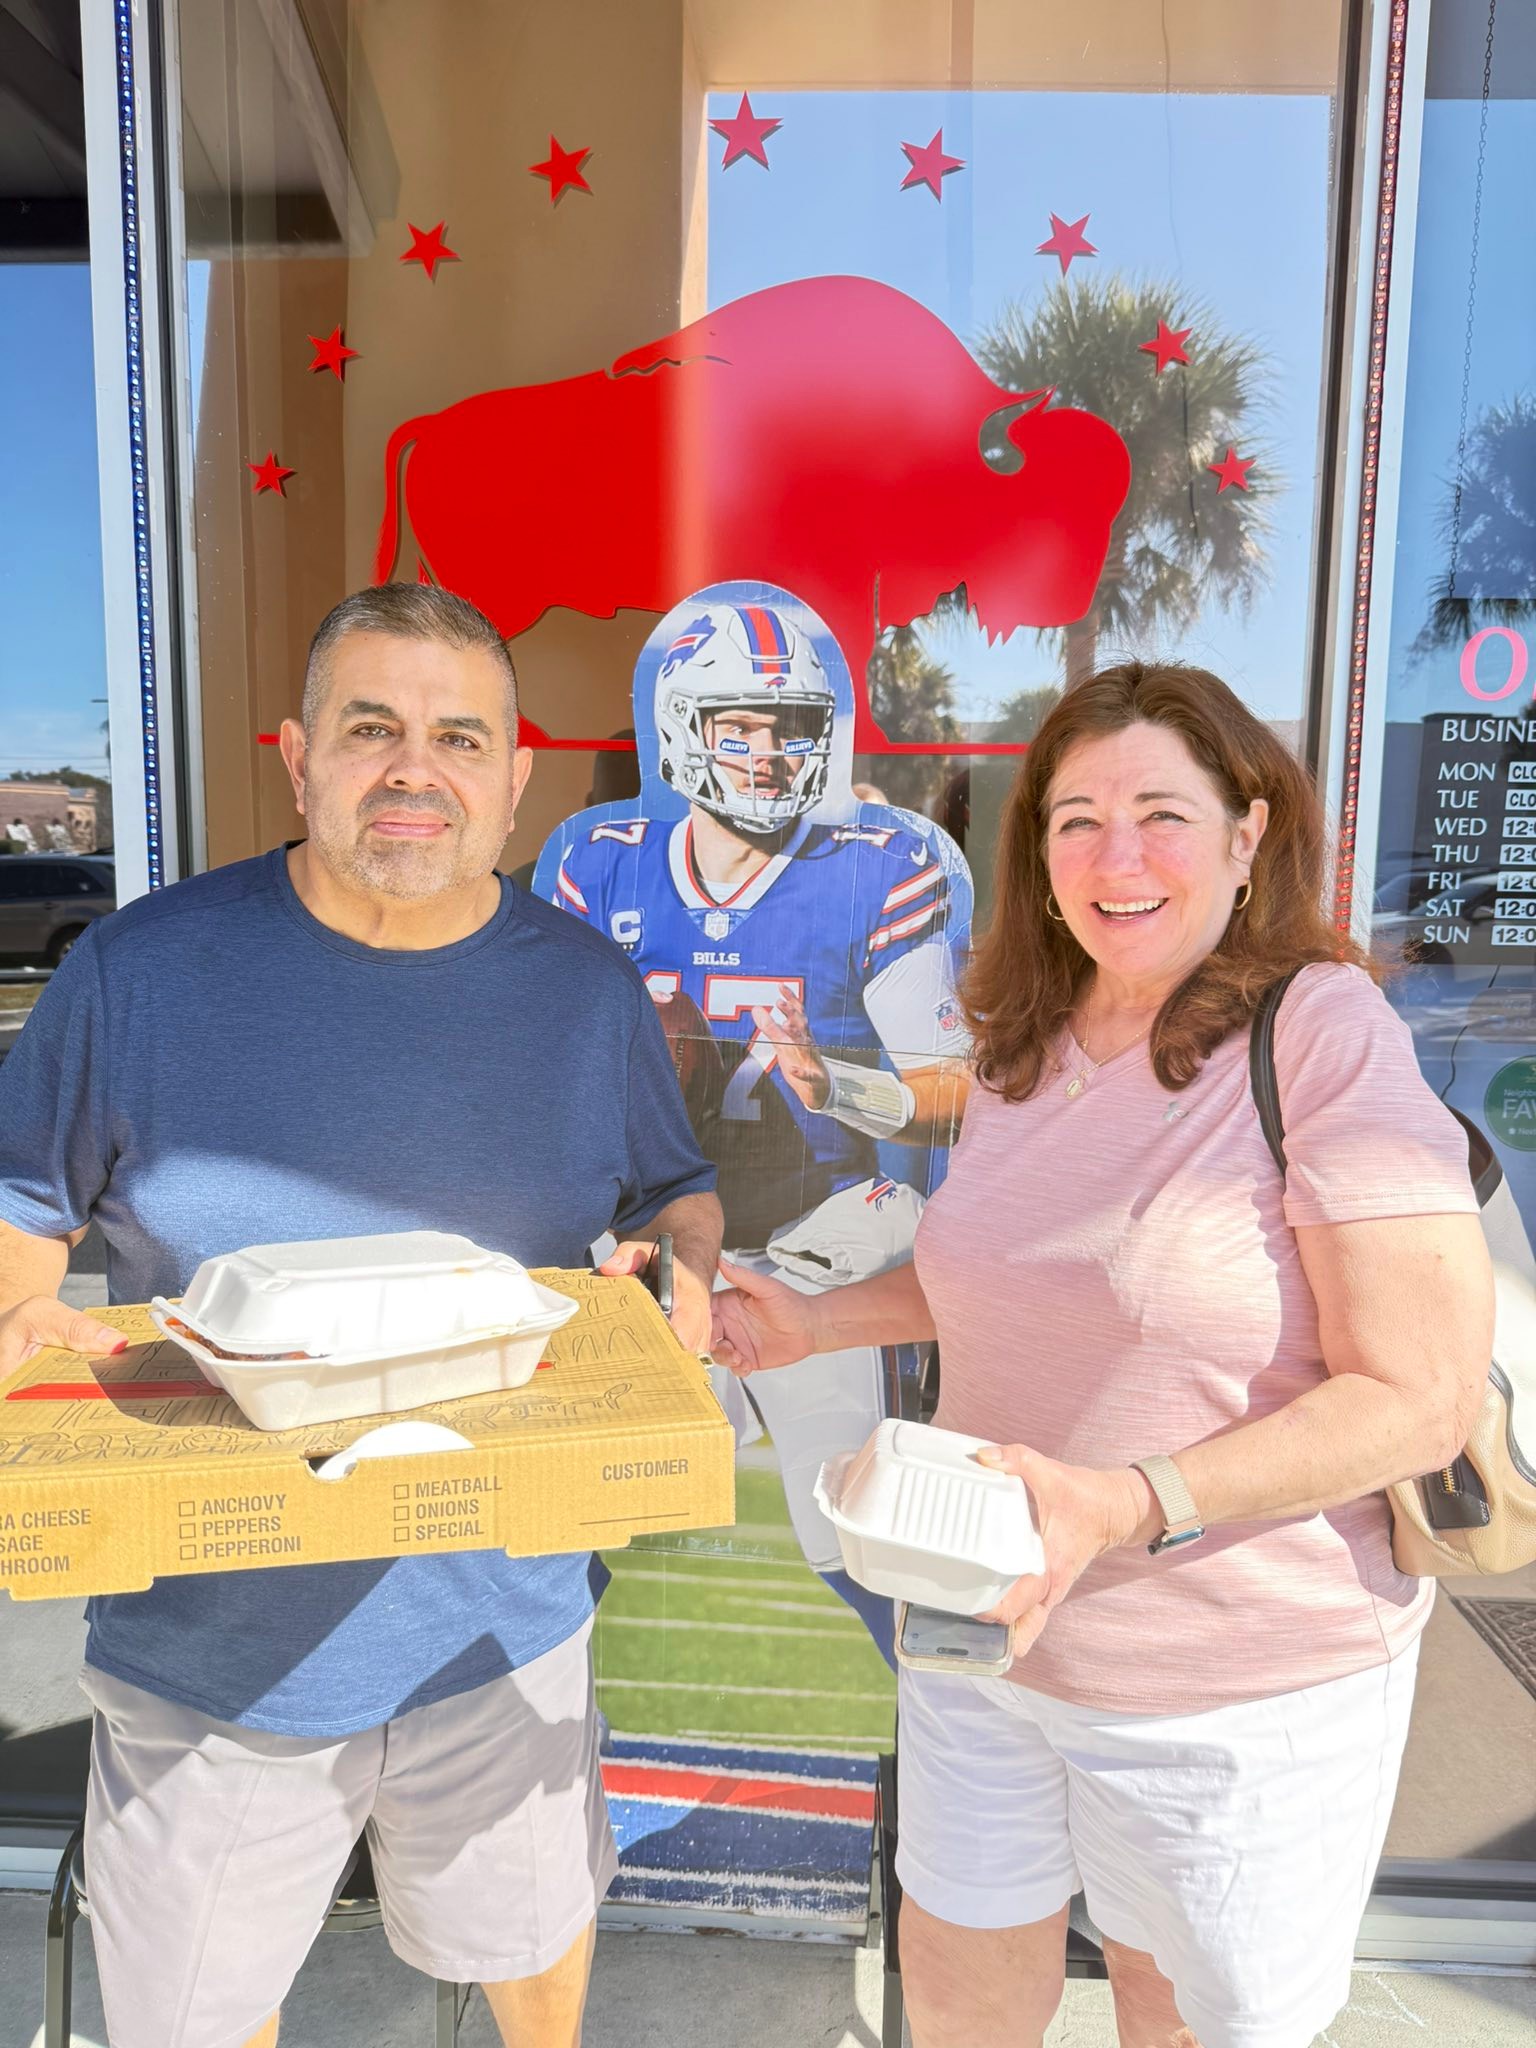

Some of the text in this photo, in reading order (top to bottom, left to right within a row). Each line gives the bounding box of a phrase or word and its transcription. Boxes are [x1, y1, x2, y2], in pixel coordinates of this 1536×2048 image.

[1460, 626, 1536, 701] O
[1438, 762, 1496, 781] MON
[1437, 789, 1479, 808] TUE
[1434, 817, 1487, 836] WED
[1431, 844, 1480, 863] THU
[1427, 872, 1461, 890] FRI
[1425, 898, 1466, 917] SAT
[1423, 925, 1470, 944] SUN
[692, 952, 741, 966] BILLS
[602, 1458, 690, 1482] CUSTOMER
[415, 1476, 502, 1498] MEATBALL
[202, 1494, 287, 1515] ANCHOVY
[416, 1499, 480, 1519] ONIONS
[22, 1508, 91, 1529] CHEESE
[202, 1516, 282, 1537] PEPPERS
[415, 1520, 485, 1541] SPECIAL
[203, 1535, 302, 1559] PEPPERONI
[1, 1555, 70, 1576] HROOM
